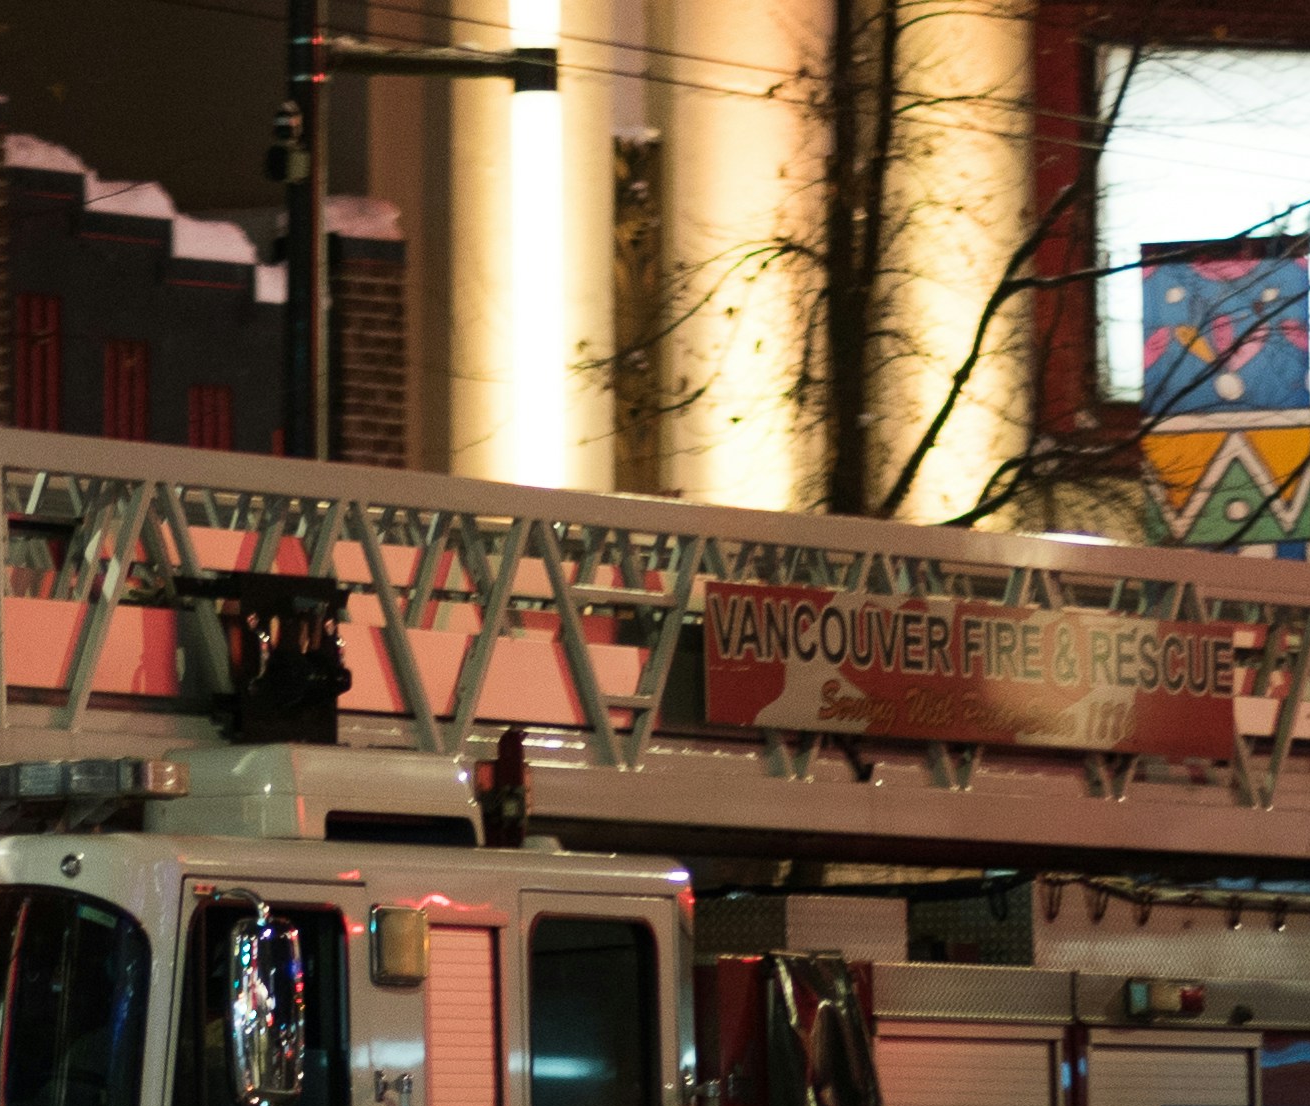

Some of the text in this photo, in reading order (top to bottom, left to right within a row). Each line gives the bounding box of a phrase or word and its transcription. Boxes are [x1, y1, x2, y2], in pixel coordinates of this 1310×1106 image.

[710, 595, 1232, 693] VANCOUVER FIRE & RESCUE
